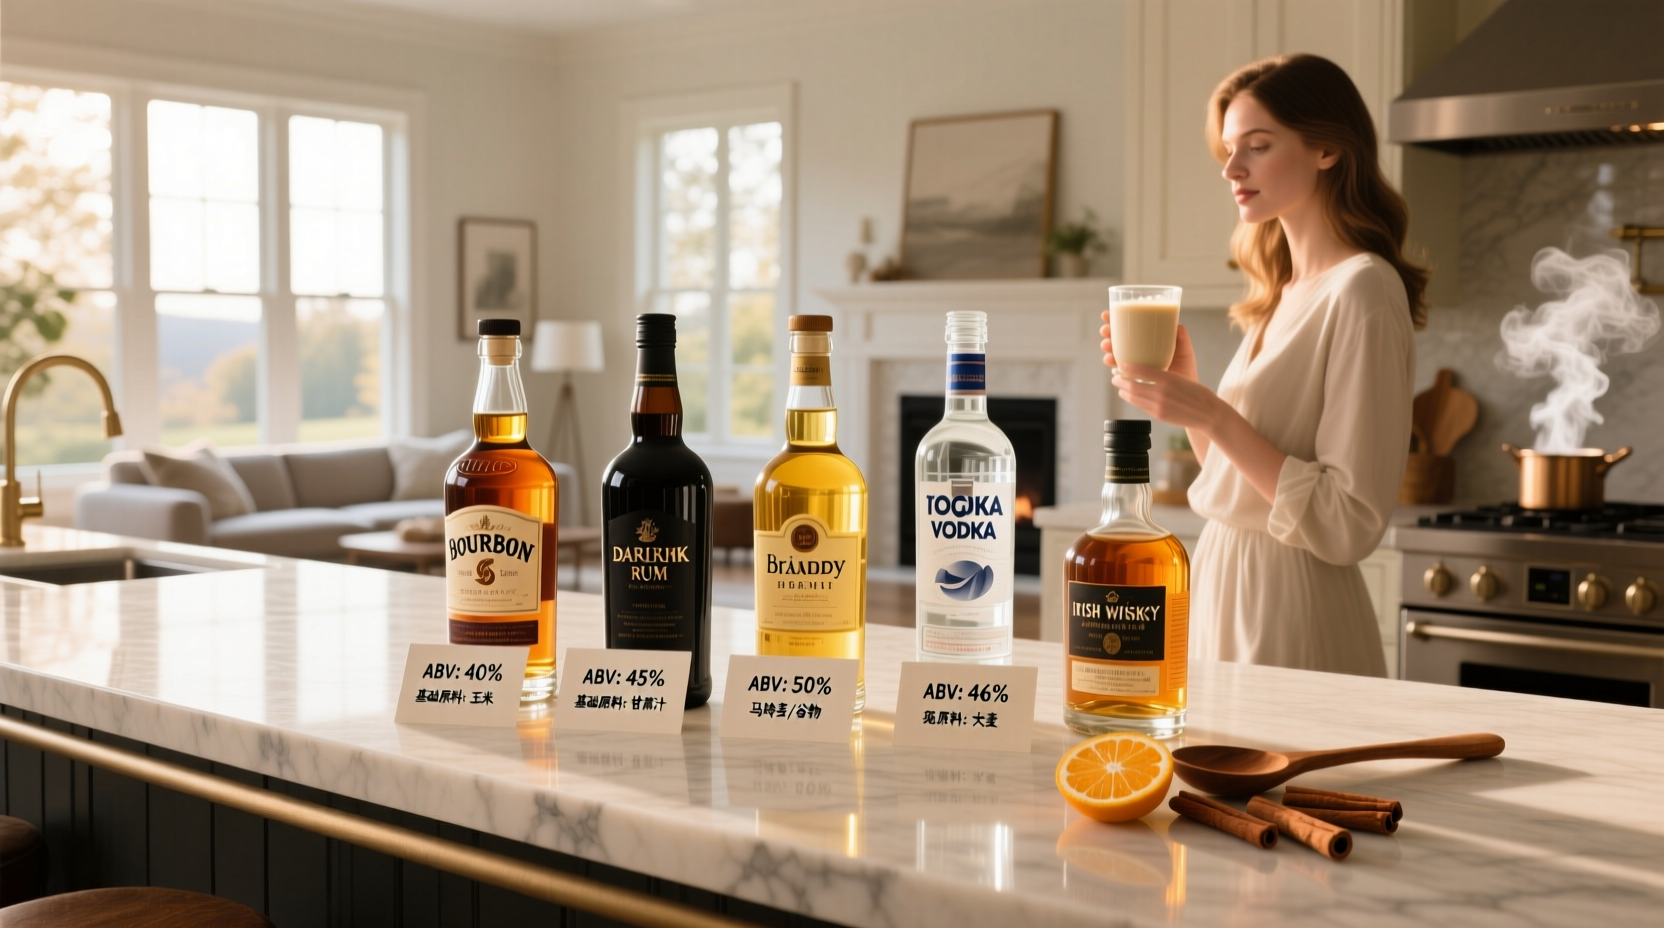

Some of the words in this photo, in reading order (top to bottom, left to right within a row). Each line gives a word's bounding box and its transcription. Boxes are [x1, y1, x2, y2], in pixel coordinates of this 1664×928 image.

[931, 521, 996, 539] VODKA
[449, 533, 535, 563] BOURBON
[631, 566, 668, 581] RUM
[422, 663, 461, 679] ABV:
[464, 663, 503, 681] 40%
[582, 669, 621, 685] ABV:
[625, 669, 665, 687] 45%
[748, 675, 787, 692] ABV:
[791, 676, 832, 695] 50%
[923, 683, 963, 700] ABV:
[967, 683, 1009, 703] 46%
